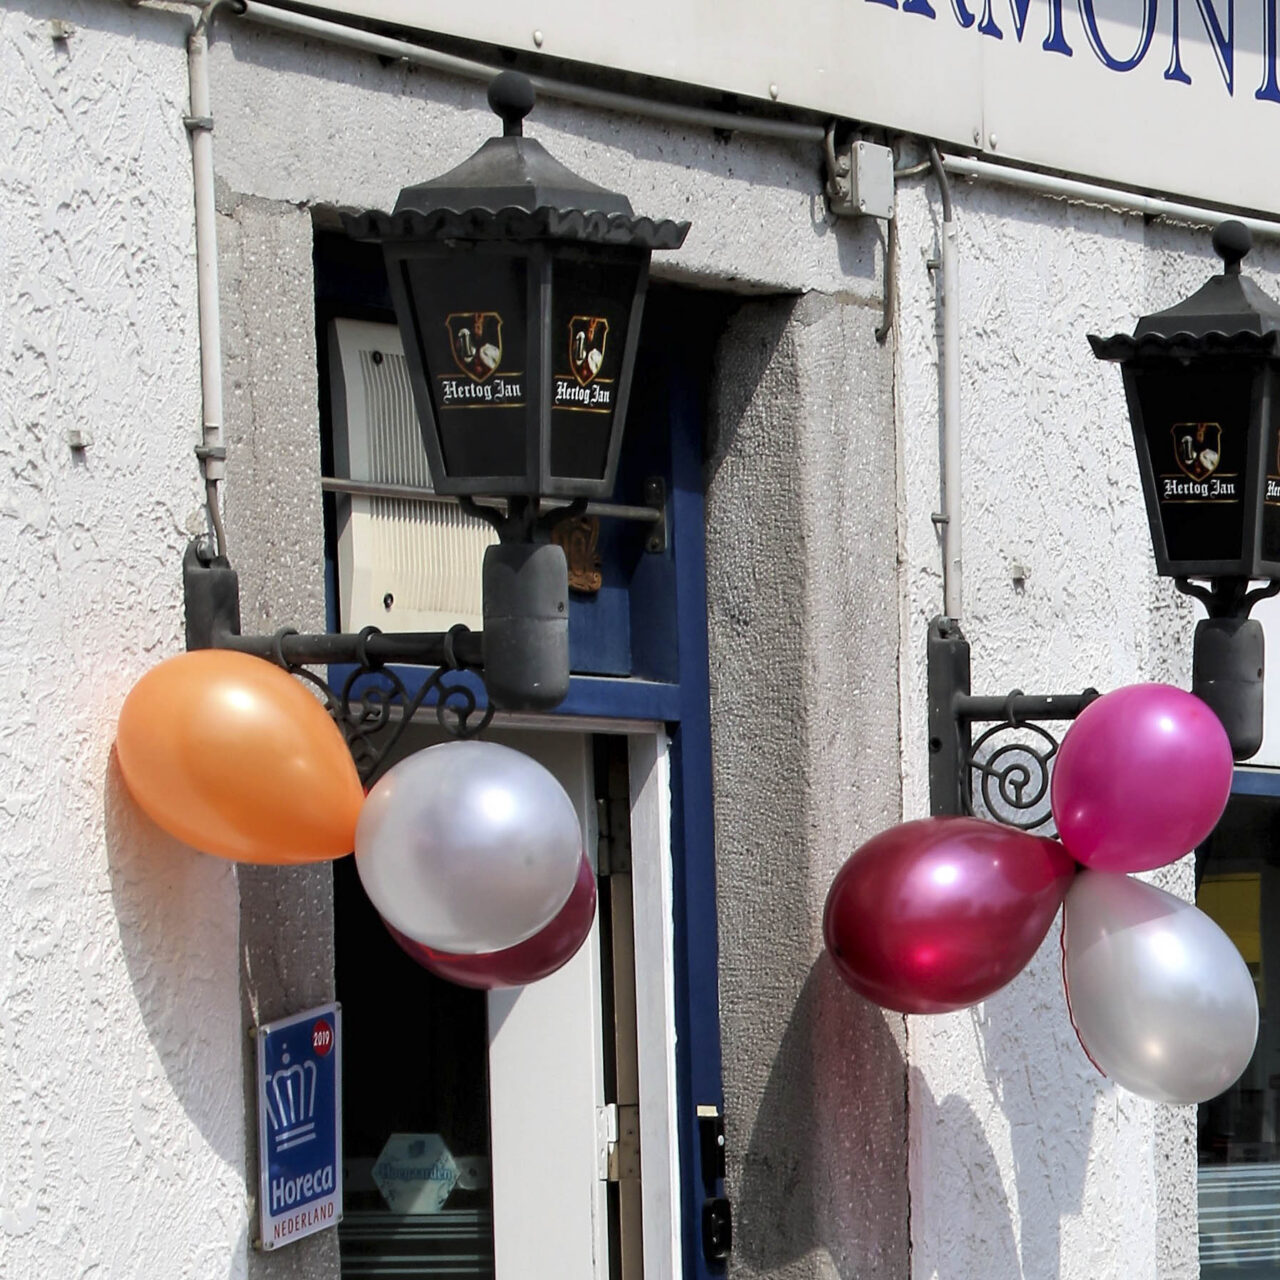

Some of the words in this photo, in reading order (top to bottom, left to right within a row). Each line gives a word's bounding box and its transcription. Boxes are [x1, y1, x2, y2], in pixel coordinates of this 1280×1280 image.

[442, 379, 492, 404] Hertog
[493, 379, 521, 403] Jan
[555, 381, 590, 405] Hertog
[590, 384, 610, 407] Jan
[1164, 480, 1208, 499] Hertog
[1209, 479, 1235, 499] Jan
[313, 1030, 330, 1047] 2019
[272, 1164, 334, 1211] Horeca
[273, 1201, 335, 1239] NEDERLAND
